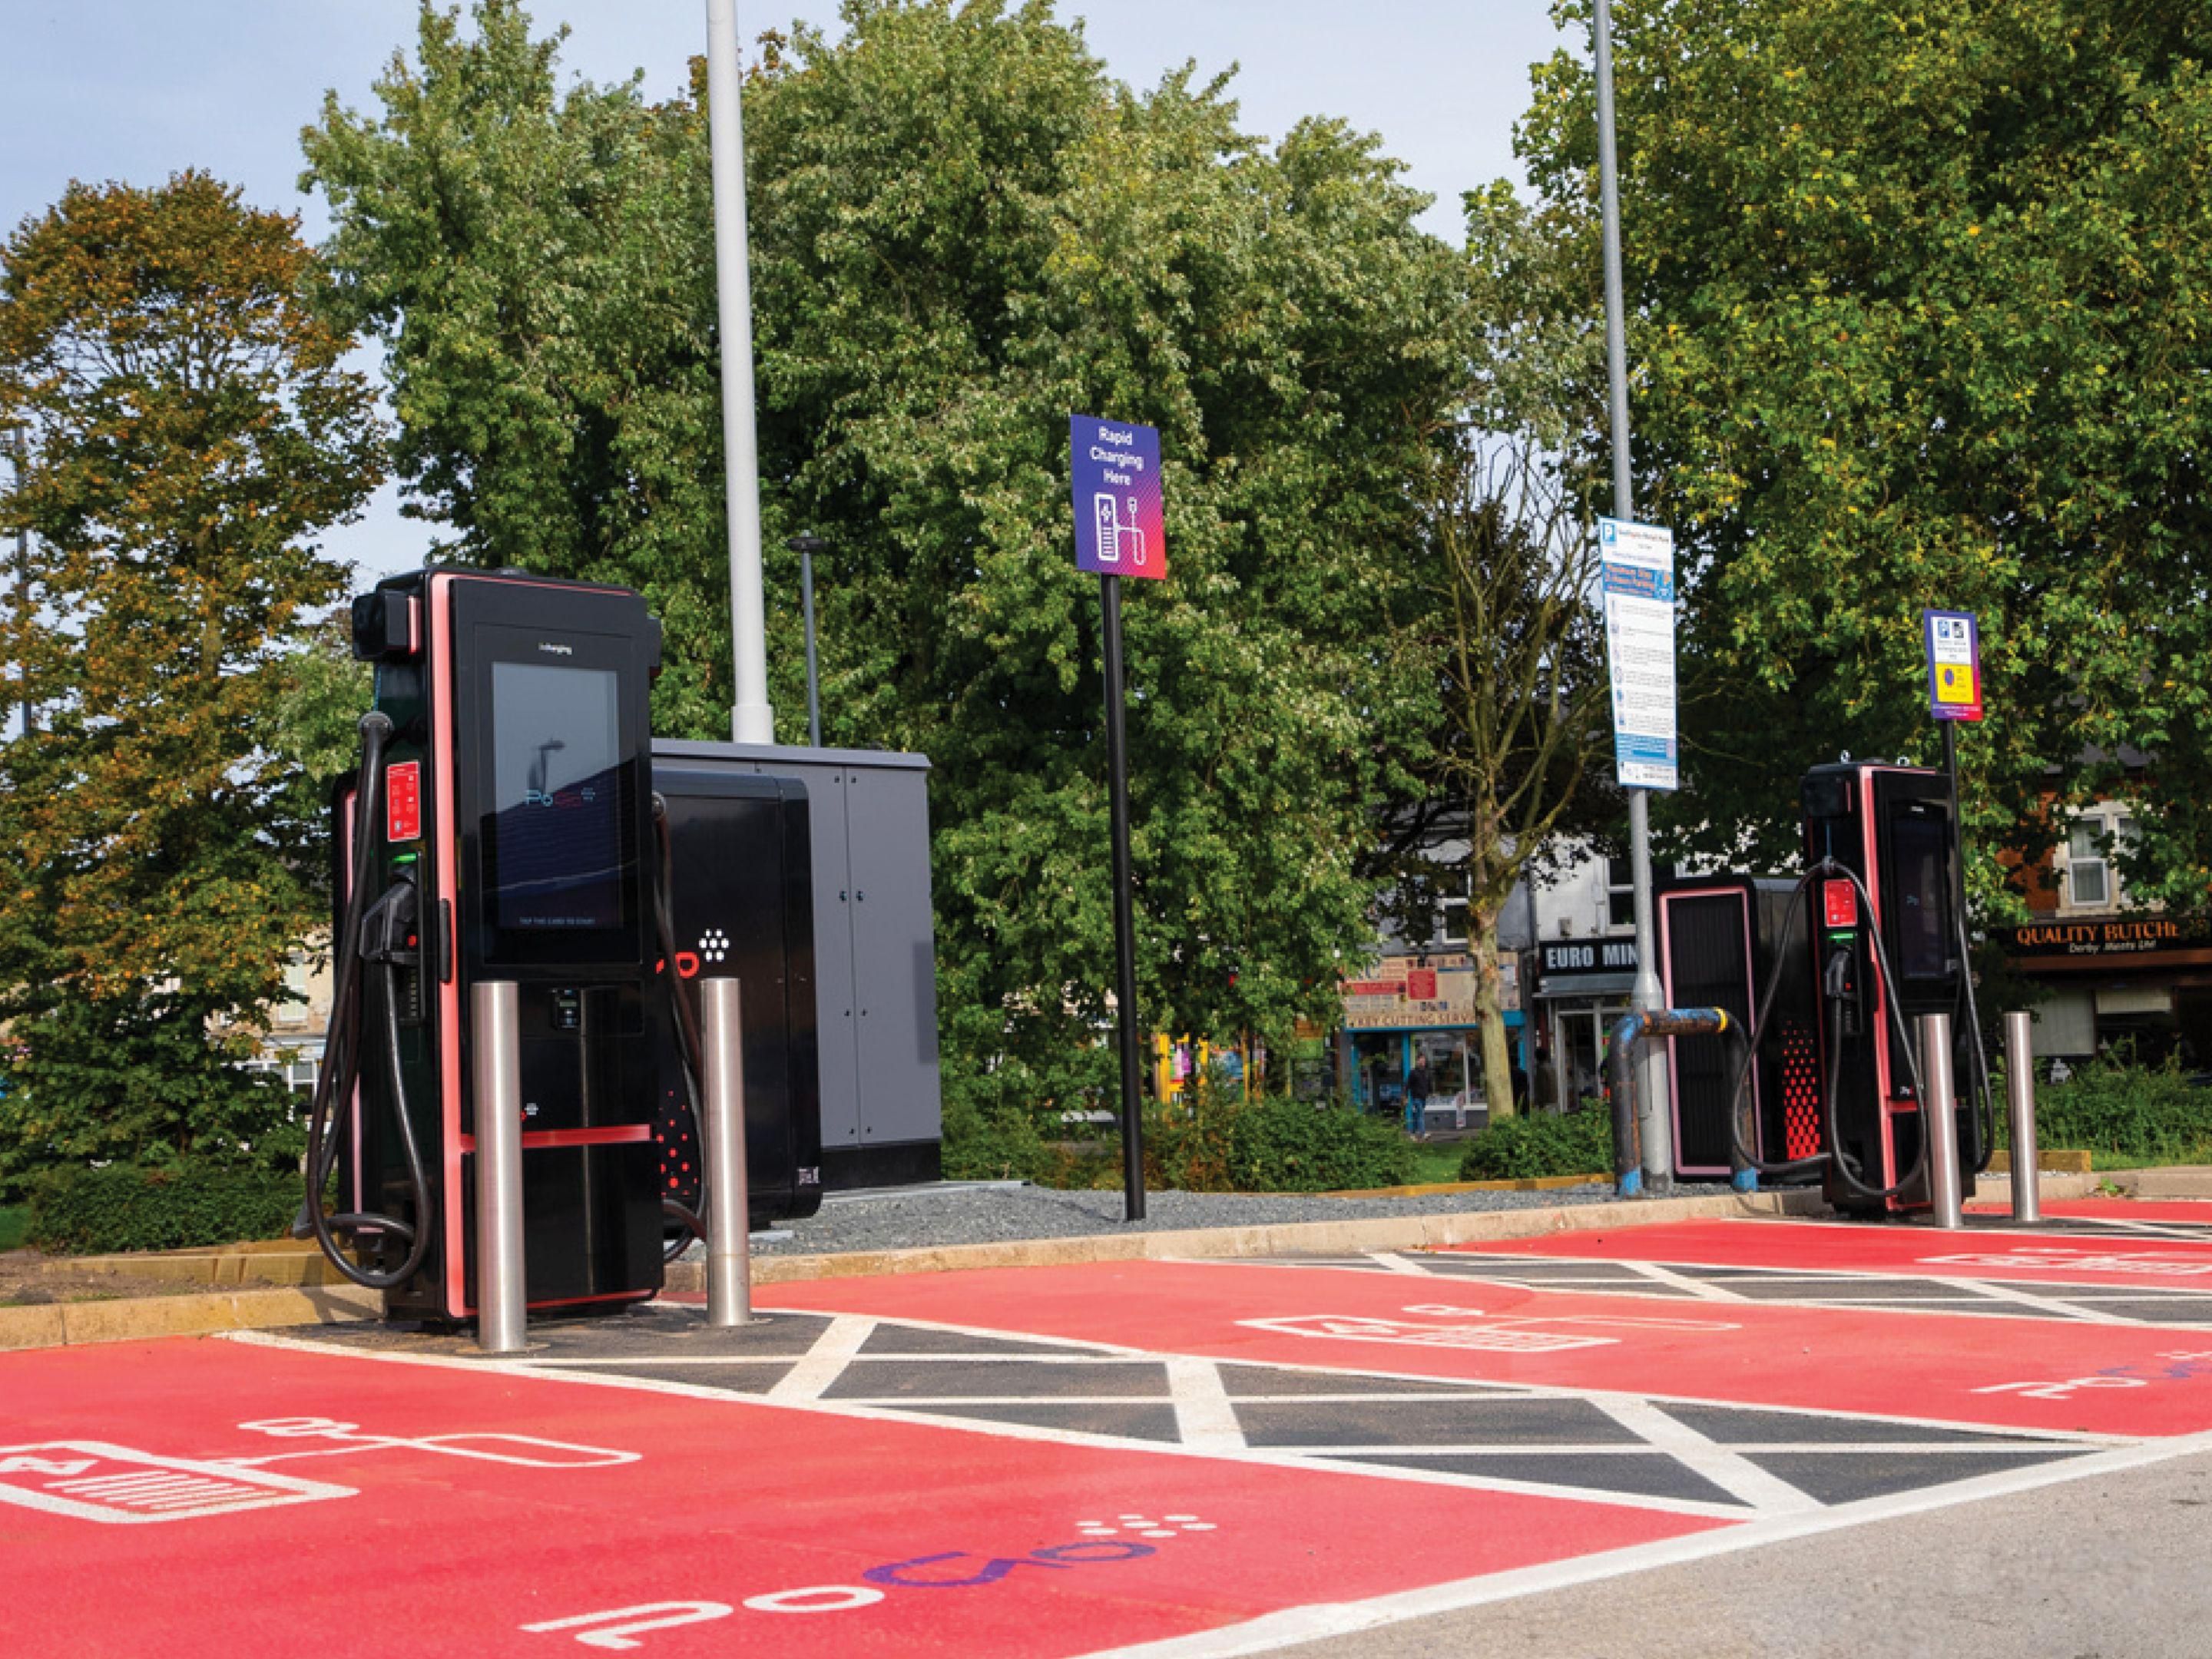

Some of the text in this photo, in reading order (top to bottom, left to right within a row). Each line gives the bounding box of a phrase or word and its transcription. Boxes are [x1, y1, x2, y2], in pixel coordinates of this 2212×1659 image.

[1098, 426, 1133, 445] Rapid
[1089, 445, 1144, 471] Charging
[1103, 468, 1131, 485] Here
[2017, 926, 2097, 945] QUALITY
[1546, 946, 1594, 969] EURO
